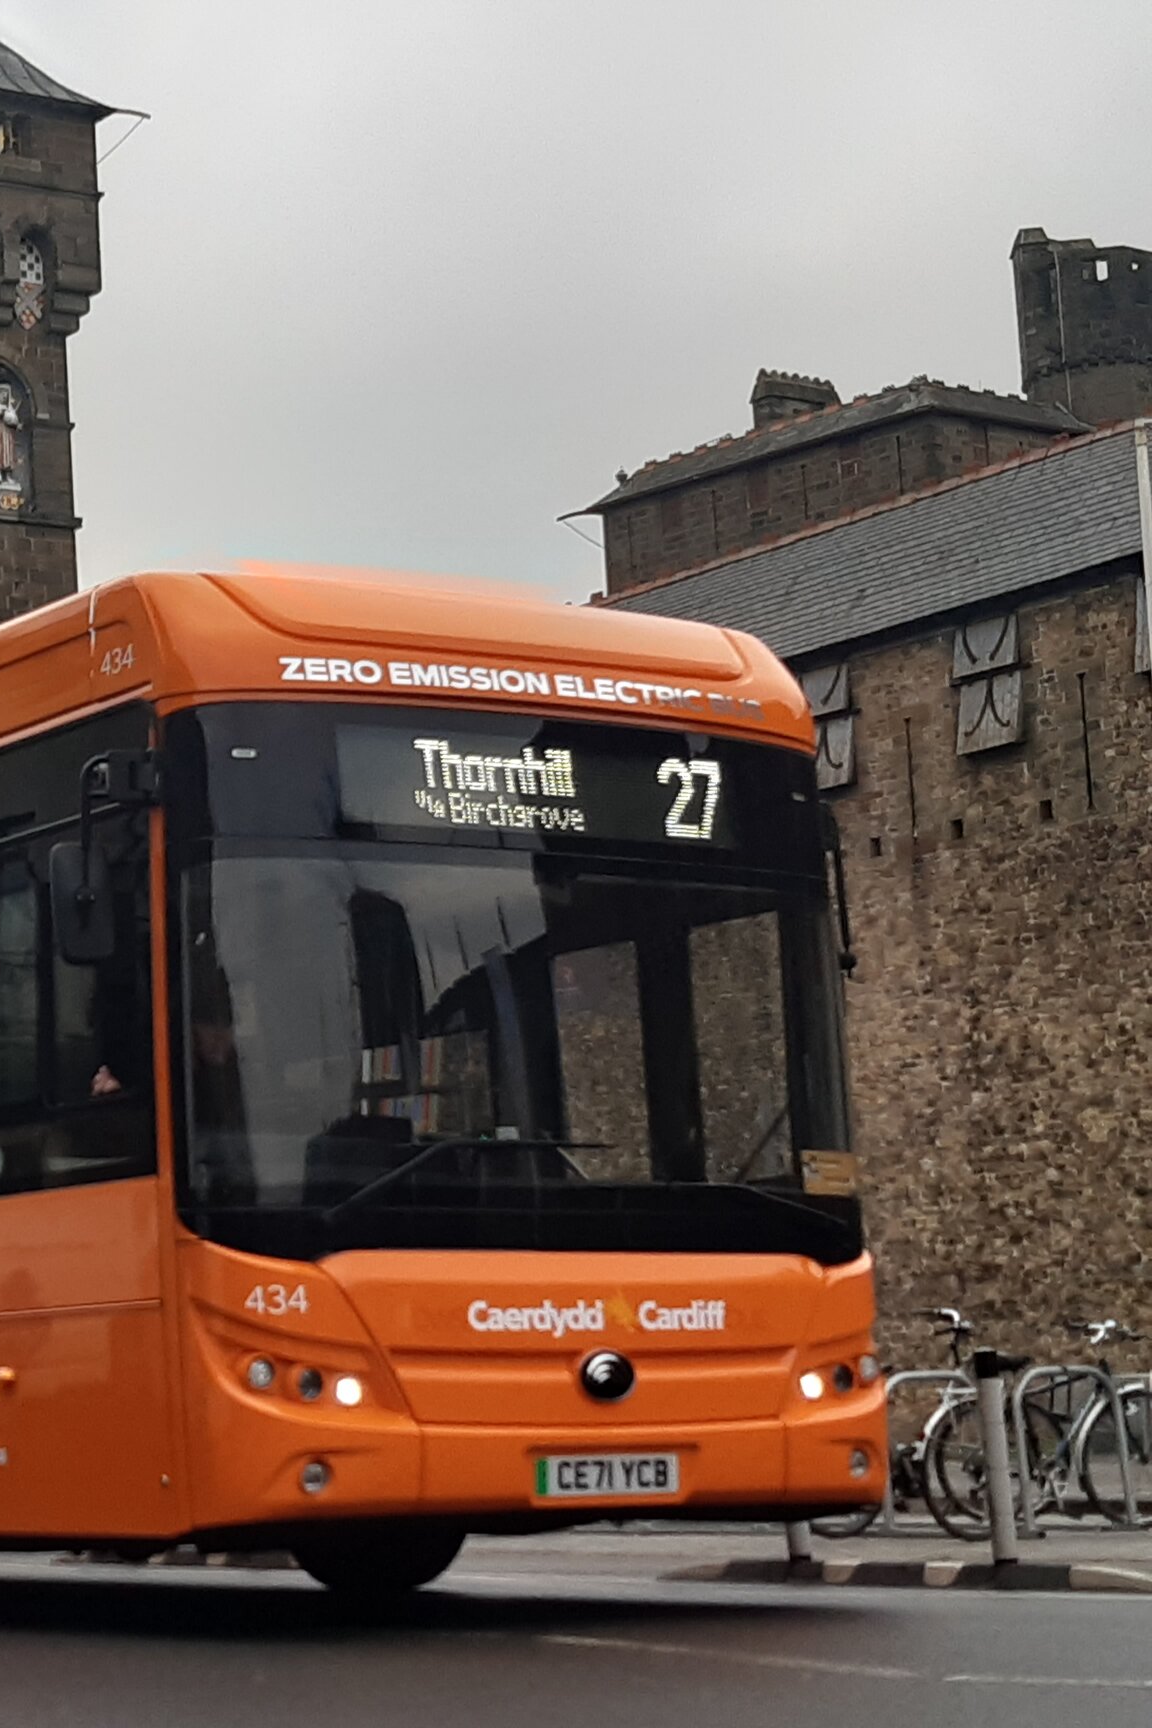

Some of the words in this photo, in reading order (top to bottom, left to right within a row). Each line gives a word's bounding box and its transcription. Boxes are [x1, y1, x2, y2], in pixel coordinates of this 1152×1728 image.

[100, 645, 135, 676] 434
[279, 657, 382, 684] ZERO
[388, 662, 550, 695] EMISSION
[553, 674, 704, 713] ELECTRIC
[413, 738, 576, 797] Thornhill
[657, 758, 721, 839] 27
[244, 1286, 309, 1315] 434
[467, 1299, 605, 1338] Caerdydd
[638, 1299, 727, 1331] Cardiff
[557, 1460, 613, 1490] CE71
[621, 1459, 669, 1488] YCB
